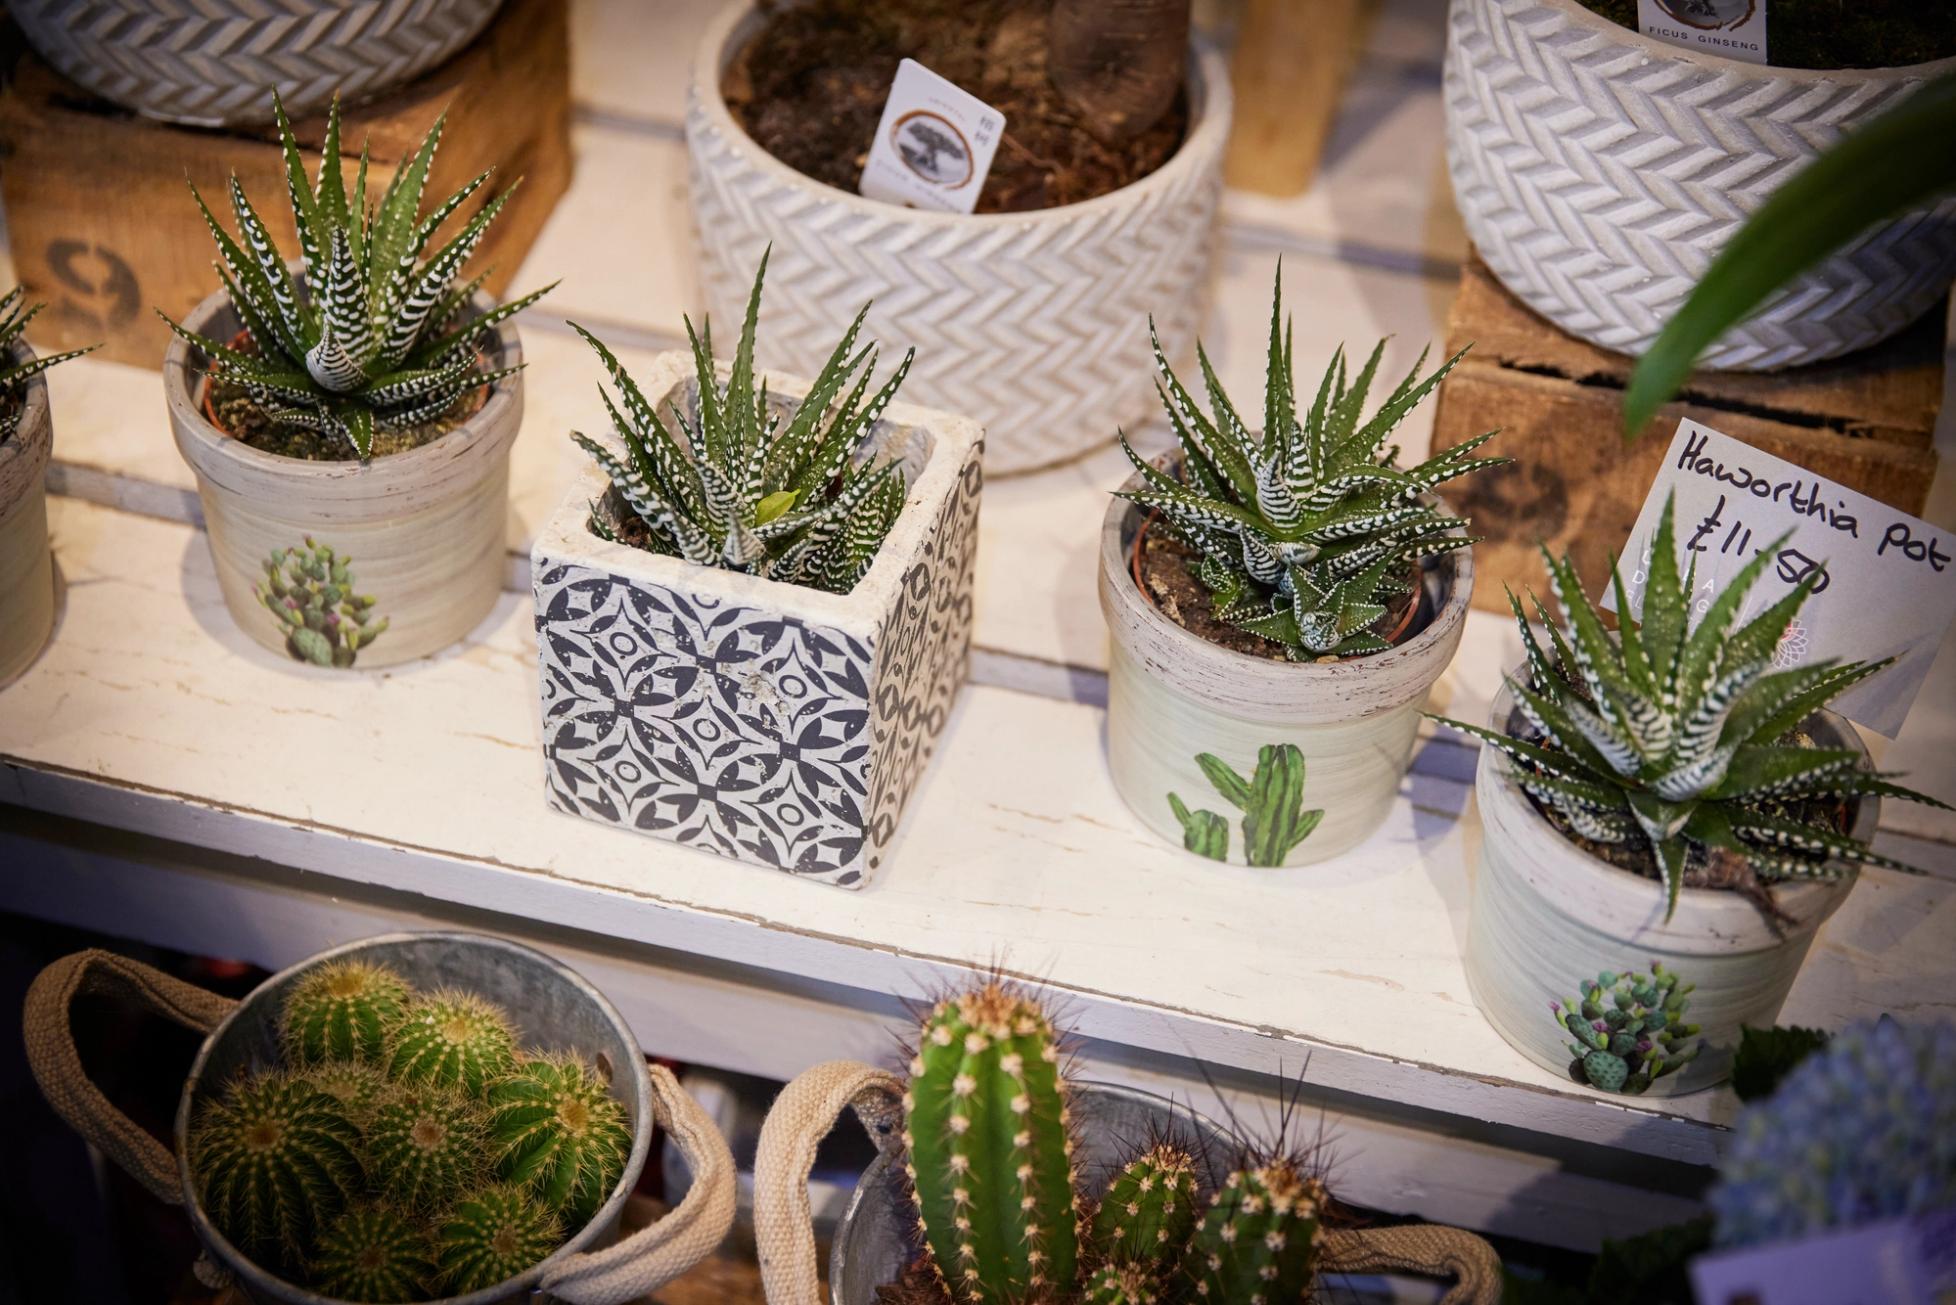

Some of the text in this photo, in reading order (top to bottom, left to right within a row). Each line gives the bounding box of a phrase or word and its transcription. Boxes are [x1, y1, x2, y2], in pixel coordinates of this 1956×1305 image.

[1649, 26, 1759, 51] FICUS GINSENG
[1677, 430, 1858, 538] Haworthia
